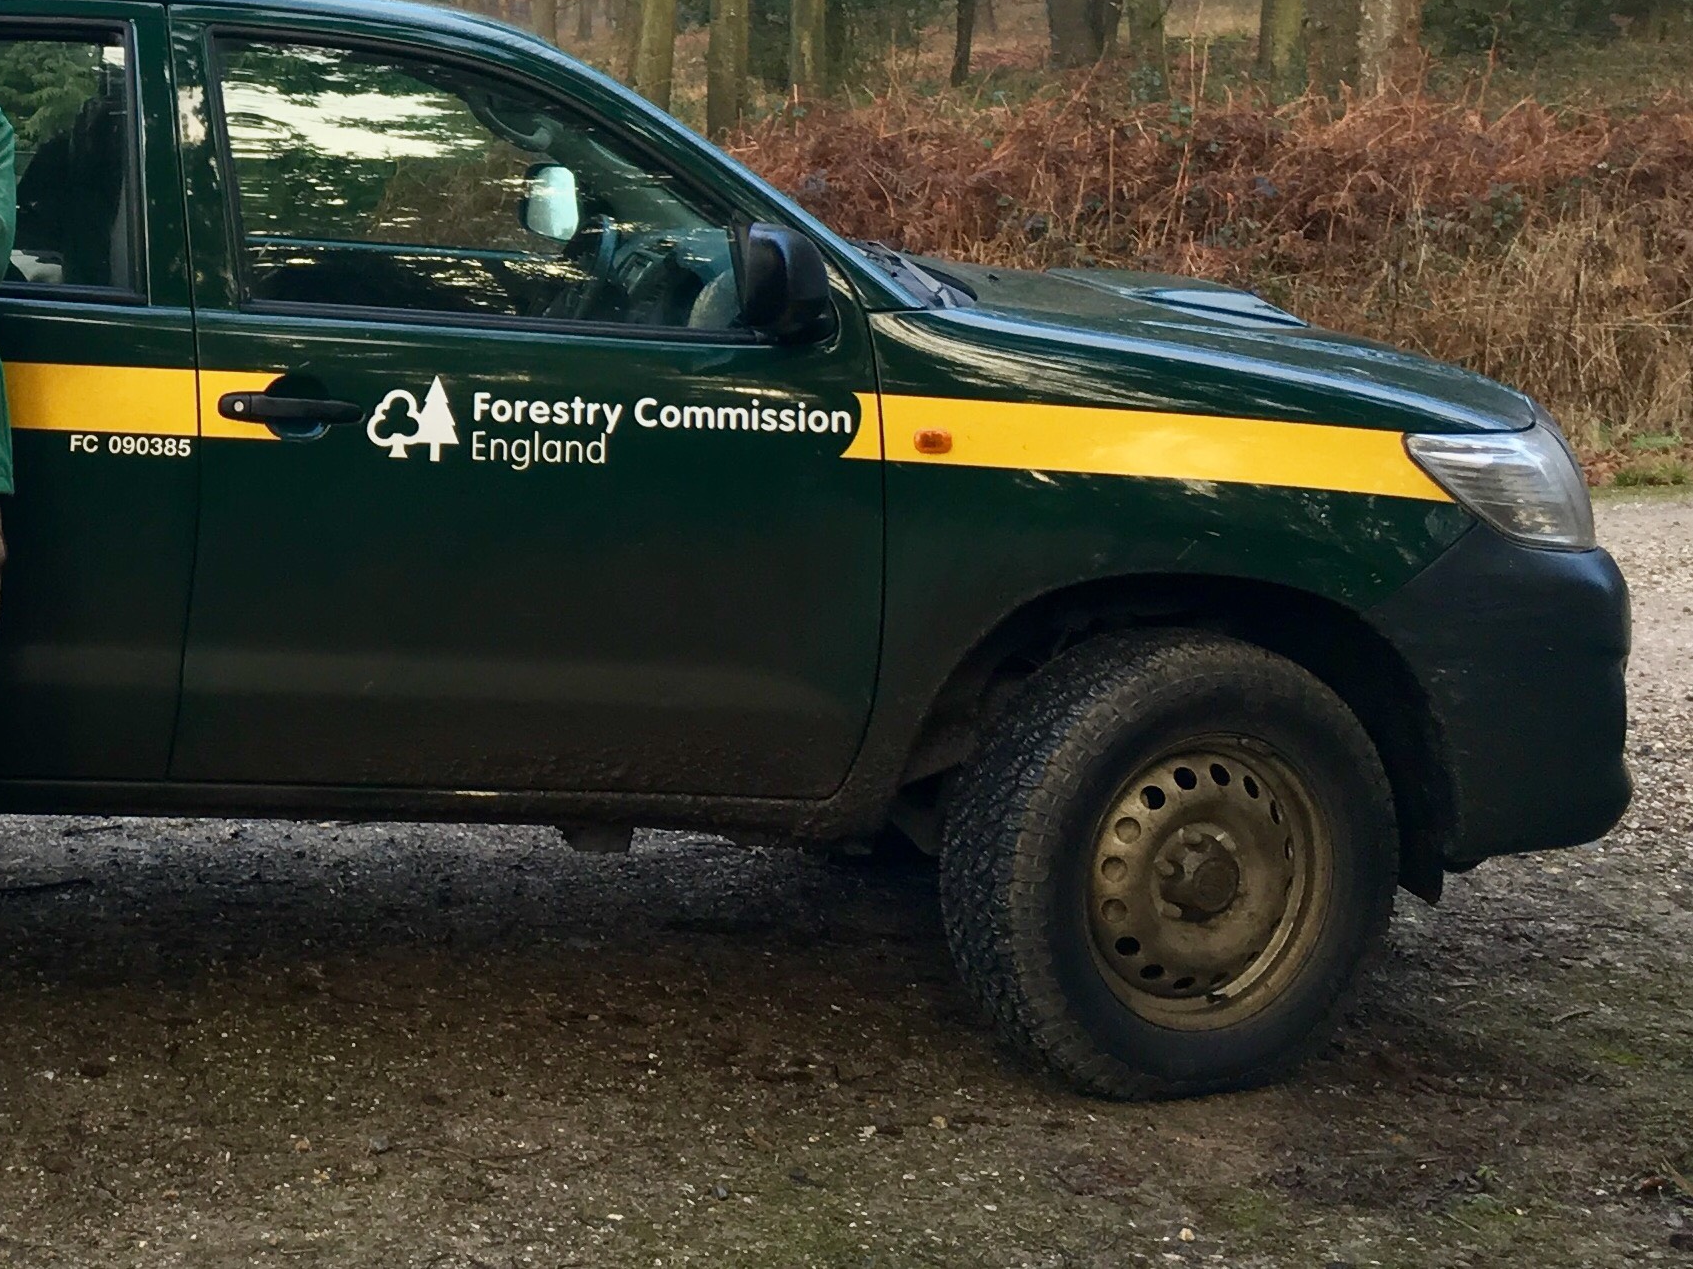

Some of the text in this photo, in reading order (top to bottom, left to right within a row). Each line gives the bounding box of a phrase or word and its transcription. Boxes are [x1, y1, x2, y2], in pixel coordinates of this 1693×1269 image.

[472, 391, 853, 435] Forestry Commission
[69, 434, 192, 457] FC 090385
[472, 430, 607, 472] England
